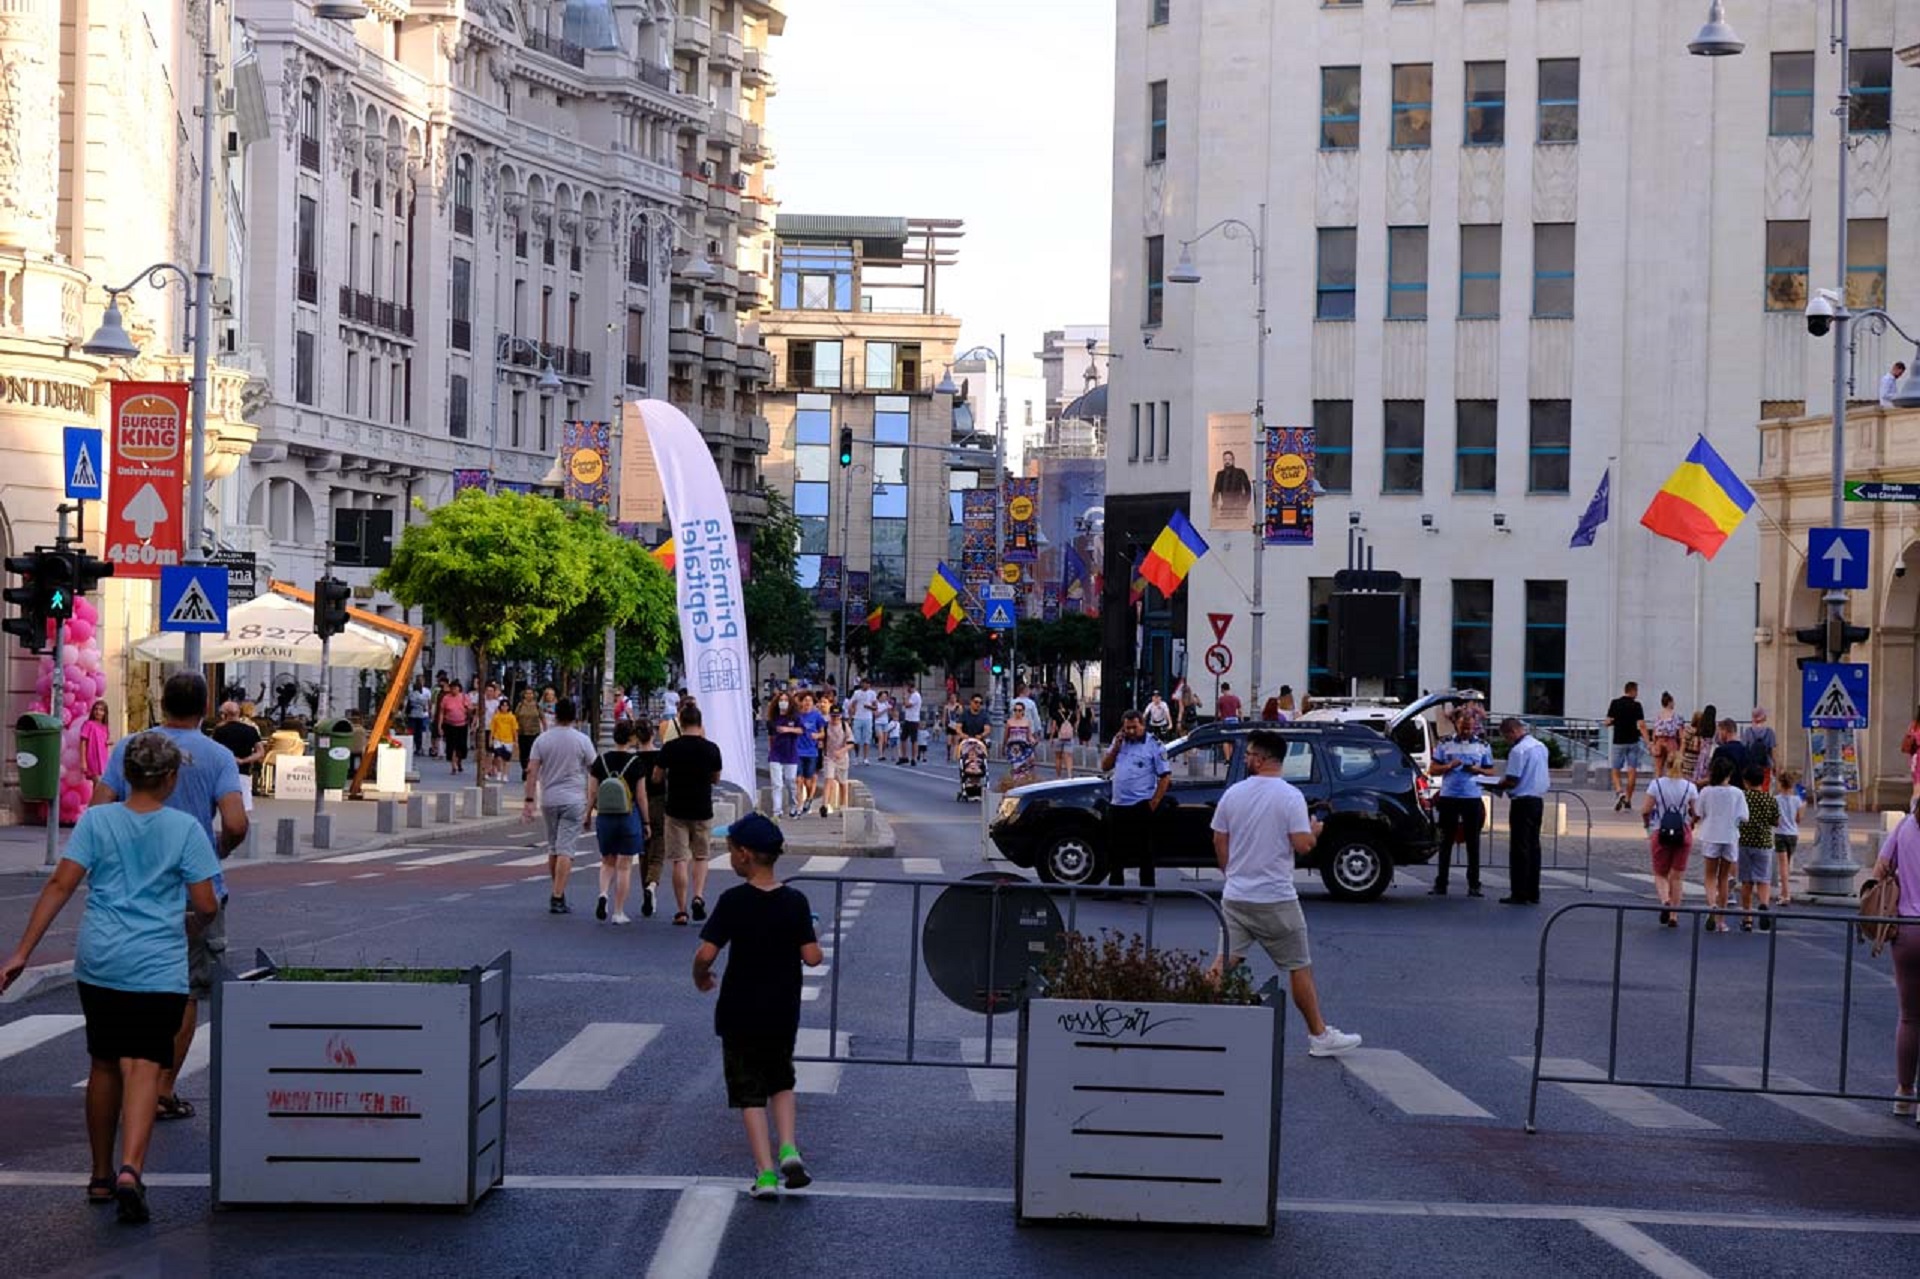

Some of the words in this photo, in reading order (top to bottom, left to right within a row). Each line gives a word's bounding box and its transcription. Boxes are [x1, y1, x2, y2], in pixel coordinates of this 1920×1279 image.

[121, 415, 176, 429] BURGER
[121, 428, 175, 447] KING
[107, 543, 178, 565] 450m
[228, 570, 252, 580] ena
[233, 646, 293, 658] PURCARI
